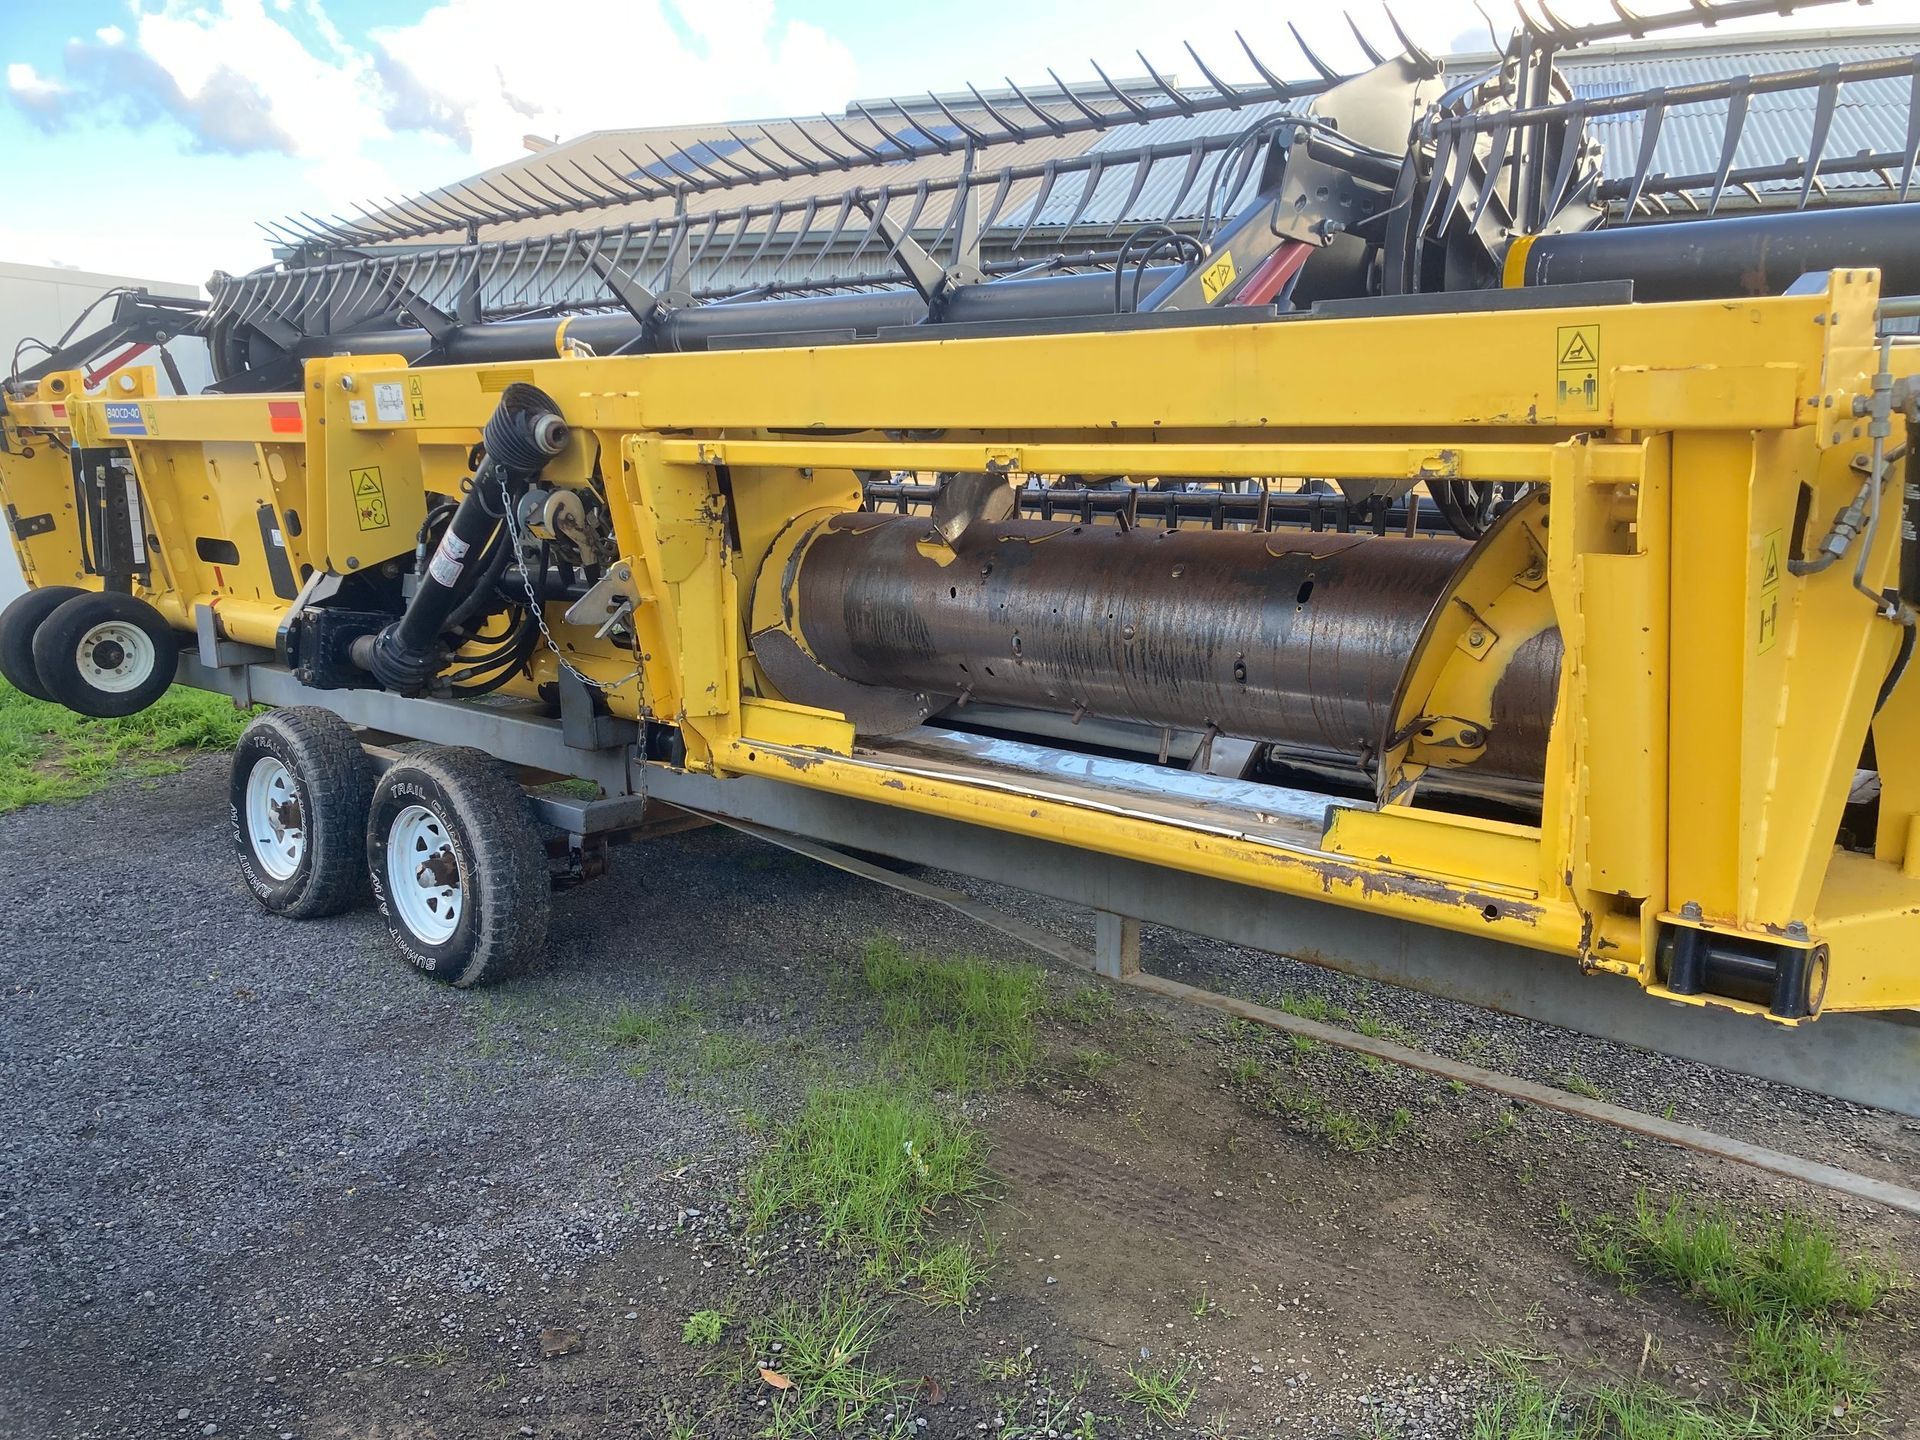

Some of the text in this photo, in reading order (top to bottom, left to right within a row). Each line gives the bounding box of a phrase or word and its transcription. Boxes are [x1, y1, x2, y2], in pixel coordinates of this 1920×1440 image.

[253, 736, 282, 758] TRAIL
[390, 782, 427, 801] TRAIL
[238, 852, 273, 899] SUMMIT
[388, 926, 437, 971] SUMMIT
